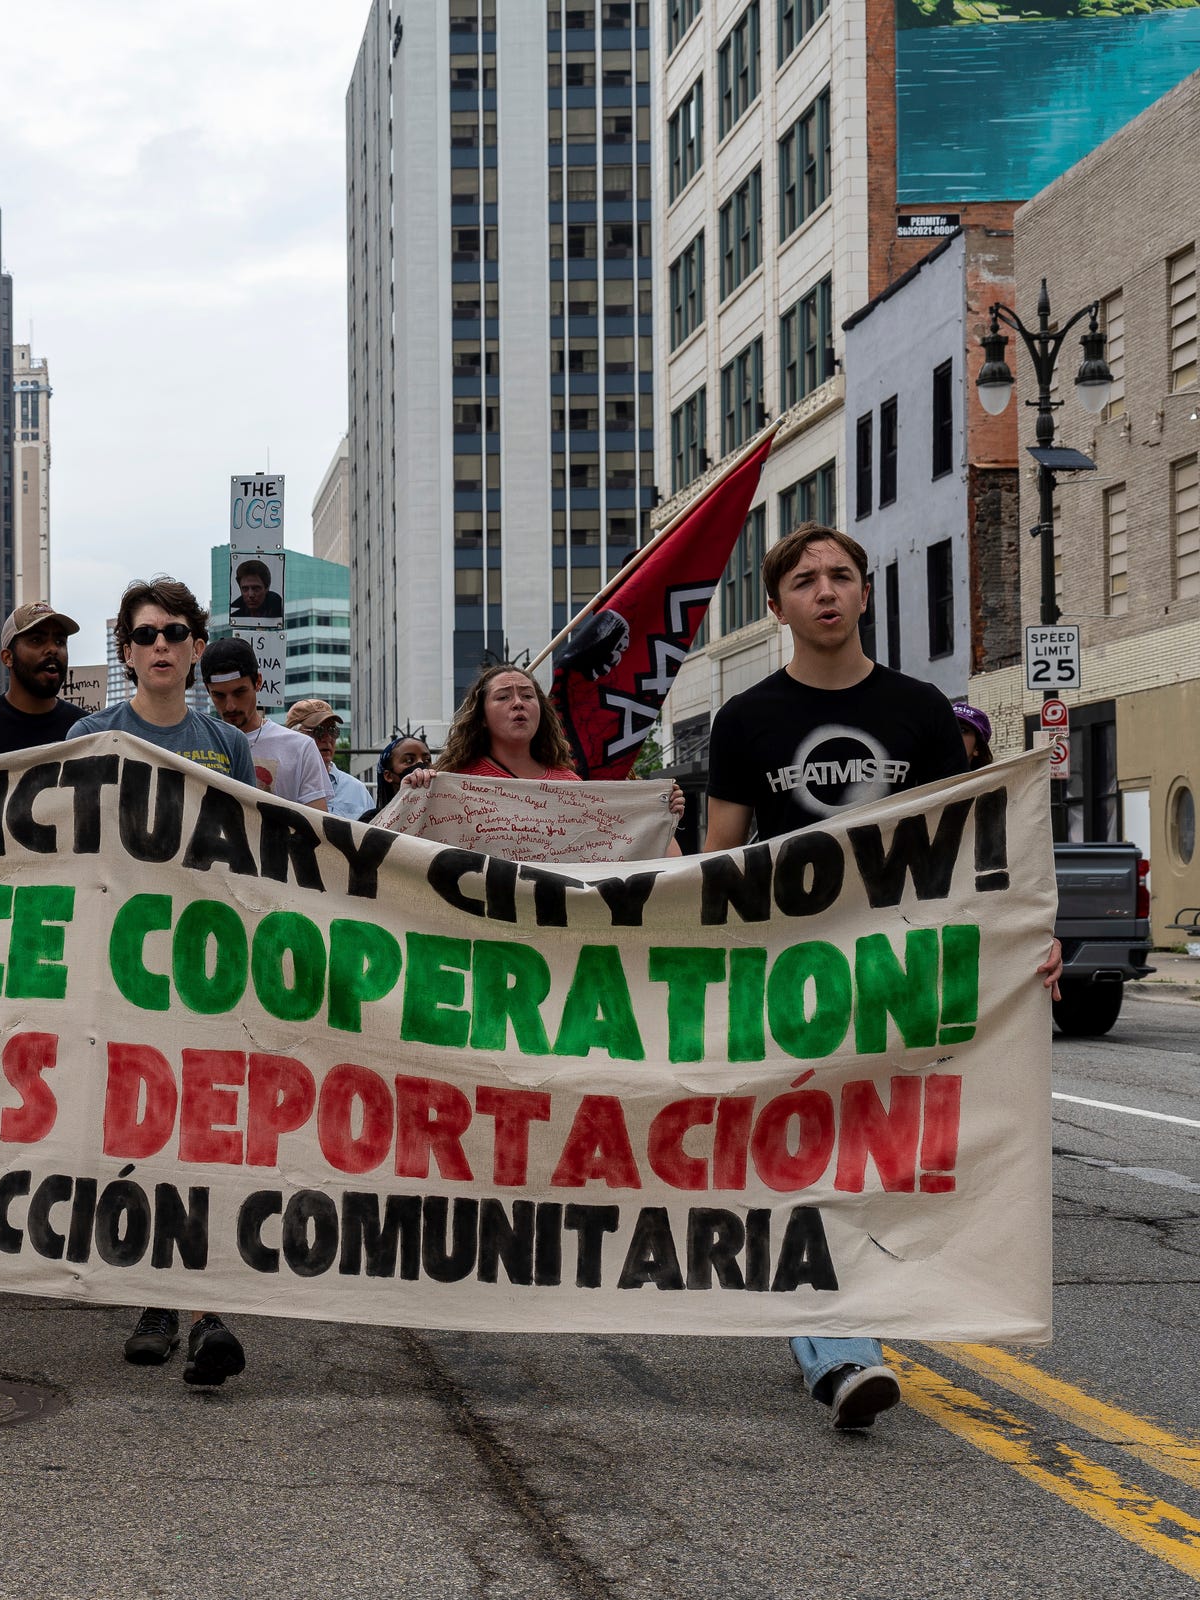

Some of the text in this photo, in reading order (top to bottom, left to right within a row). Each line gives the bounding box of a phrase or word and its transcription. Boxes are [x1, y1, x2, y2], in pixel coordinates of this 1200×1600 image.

[911, 216, 947, 226] PERMIT#
[240, 481, 278, 497] THE
[232, 498, 282, 529] ICE
[1030, 633, 1076, 643] SPEED
[1035, 646, 1071, 657] LIMIT
[61, 669, 101, 697] Human
[1032, 659, 1076, 683] 25
[766, 758, 911, 793] HEATMISER
[426, 847, 667, 927] CITY
[700, 785, 1011, 927] NOW!
[109, 893, 981, 1064] COOPERATION!
[103, 1041, 963, 1194] DEPORTACIÓN!
[236, 1189, 839, 1293] COMUNITARIA
